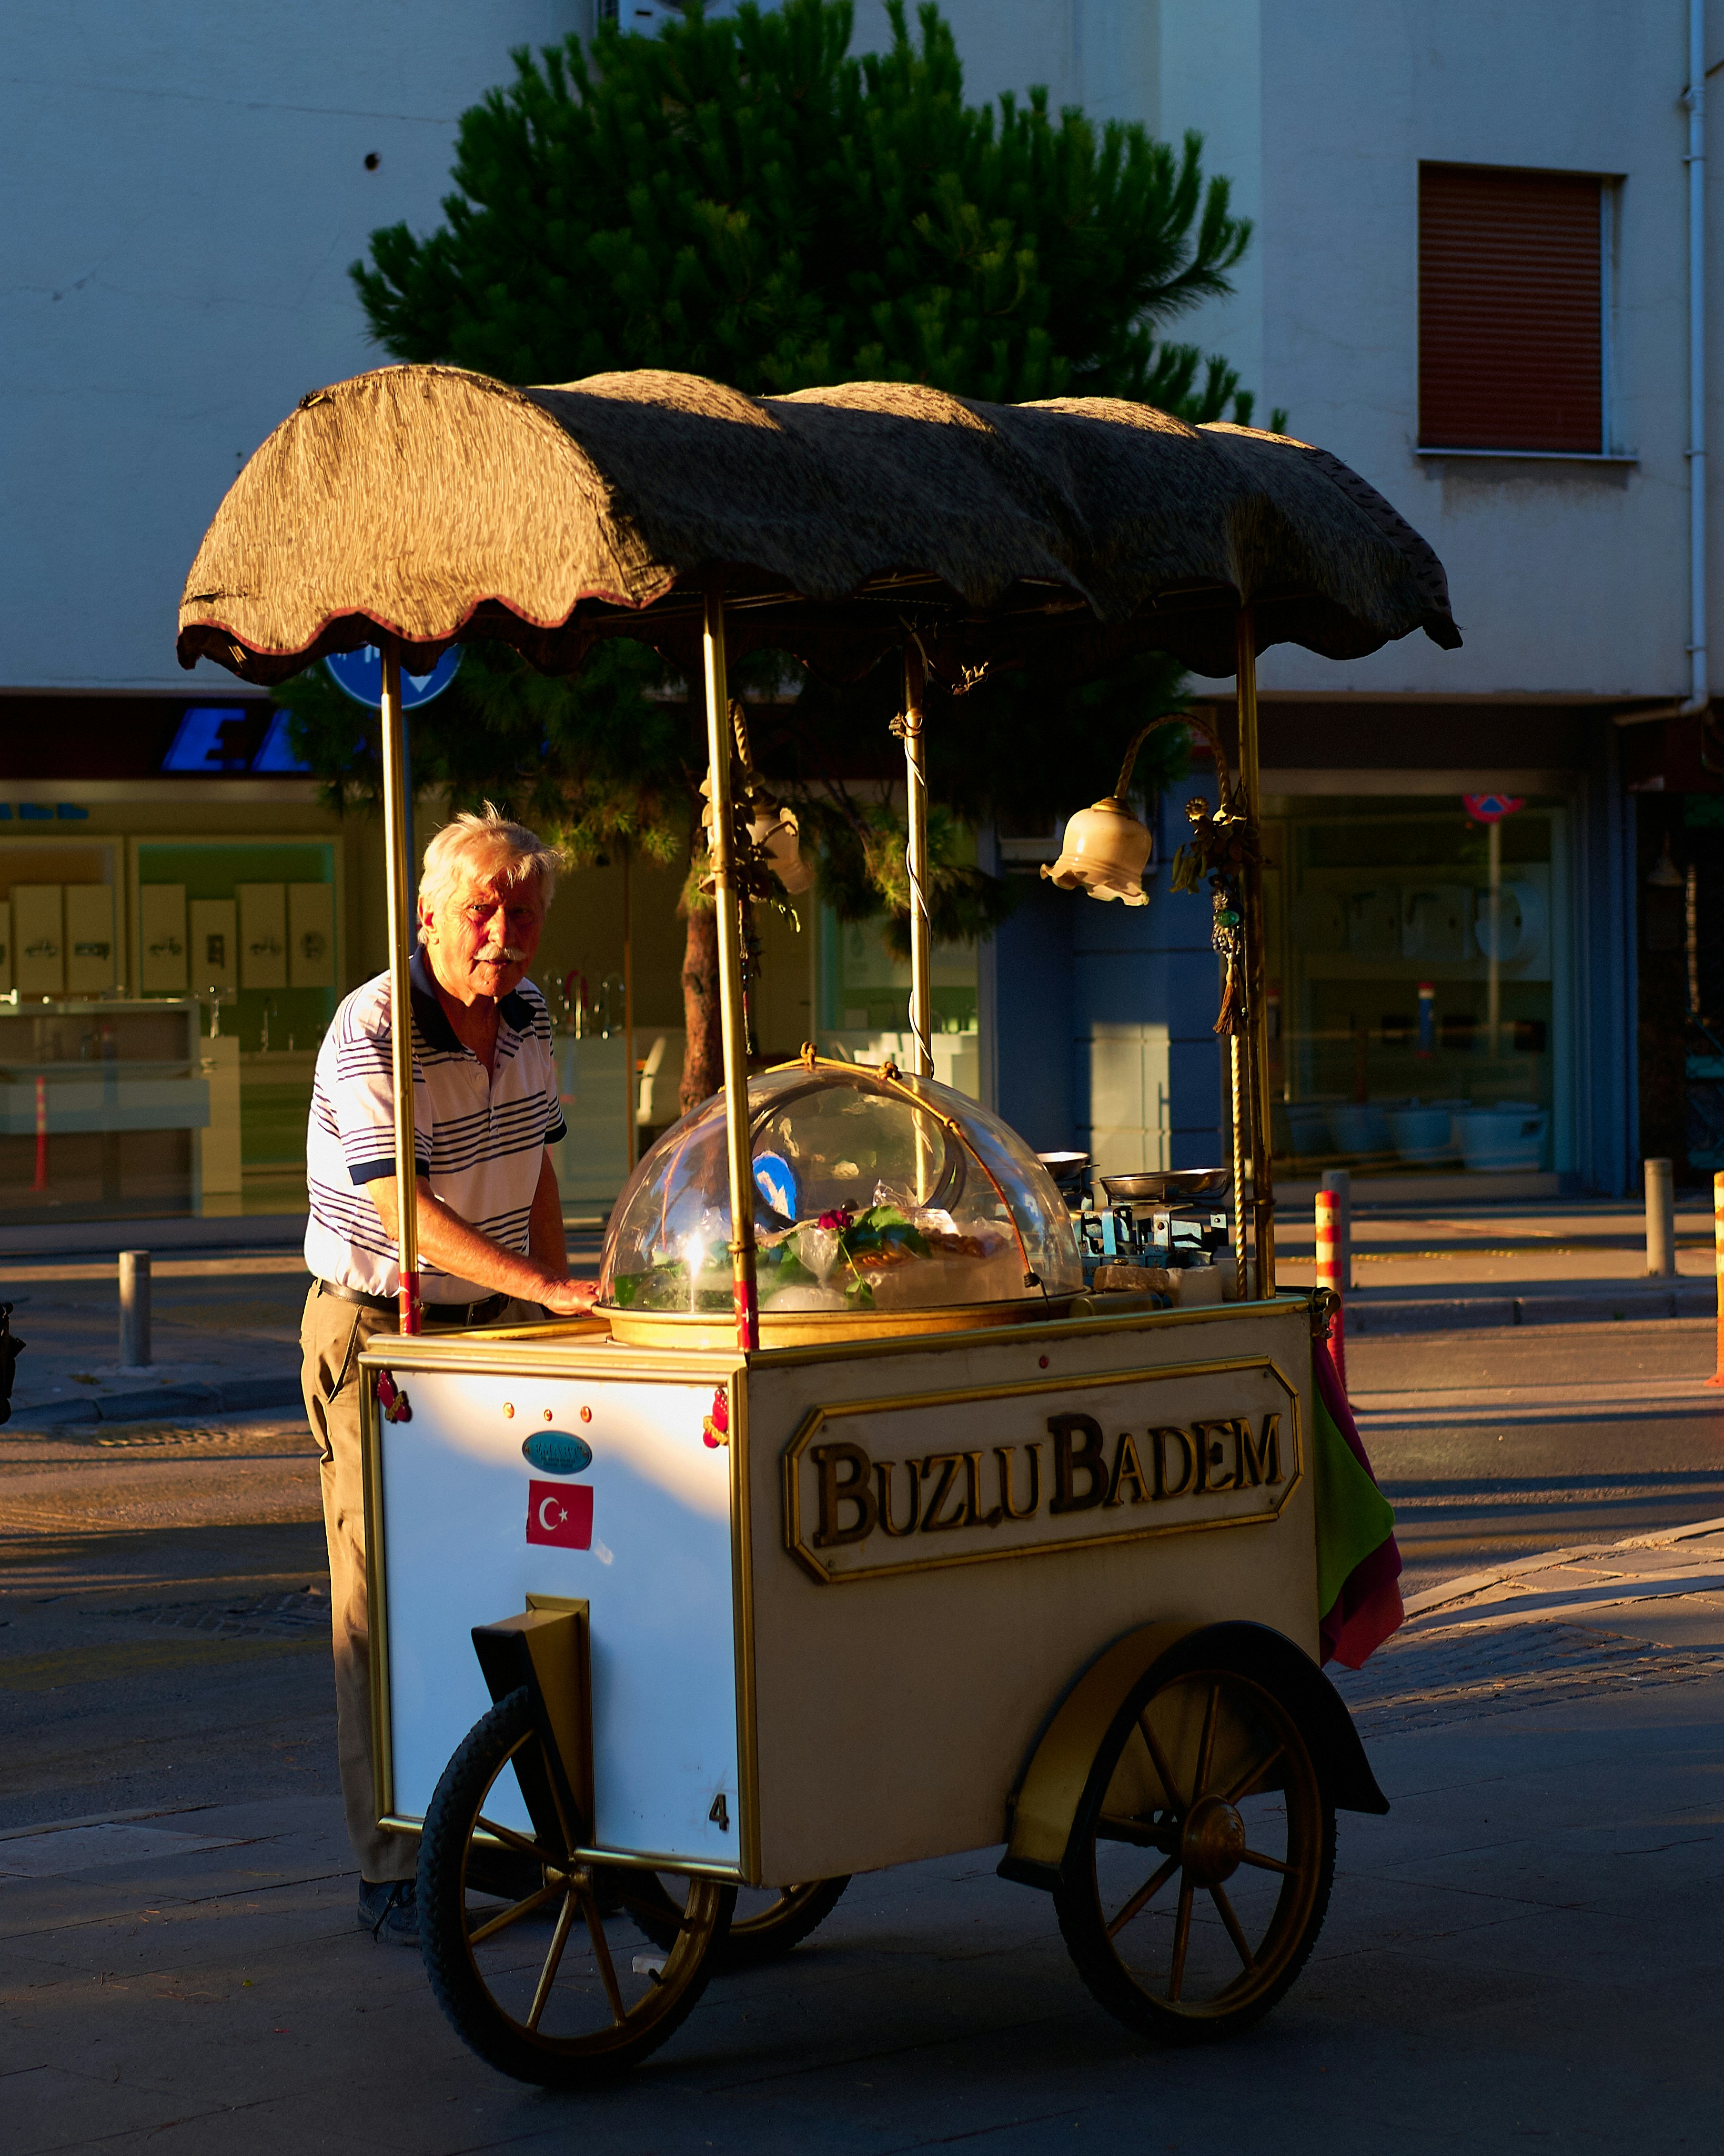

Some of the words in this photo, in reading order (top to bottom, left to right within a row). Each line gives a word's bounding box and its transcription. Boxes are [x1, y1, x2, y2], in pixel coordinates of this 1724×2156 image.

[811, 1442, 1043, 1548] BUZLU
[1047, 1412, 1286, 1514] BADEM
[709, 1793, 729, 1831] 4
